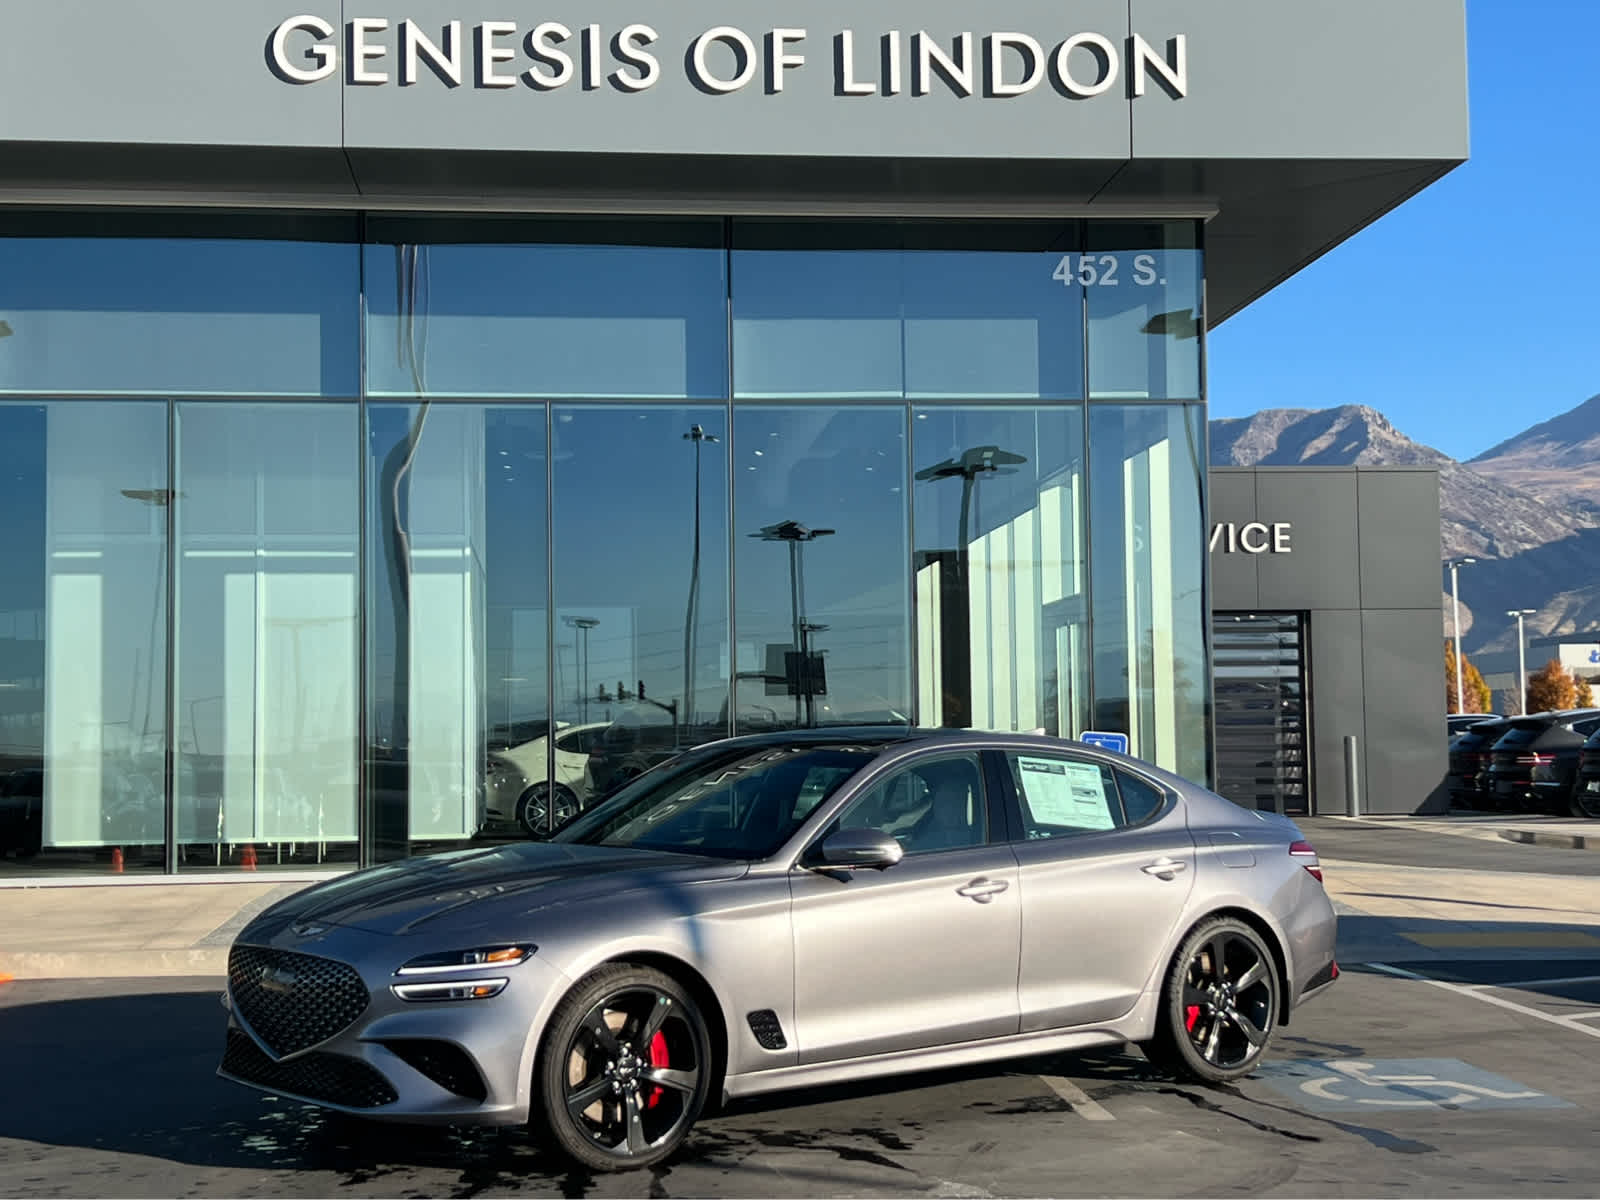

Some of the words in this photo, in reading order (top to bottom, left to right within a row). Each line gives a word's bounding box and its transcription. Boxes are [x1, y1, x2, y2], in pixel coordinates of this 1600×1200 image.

[266, 14, 660, 93] GENESIS
[685, 26, 807, 95] OF
[834, 30, 1187, 100] LINDON
[1052, 255, 1119, 287] 452
[1132, 254, 1168, 287] S.
